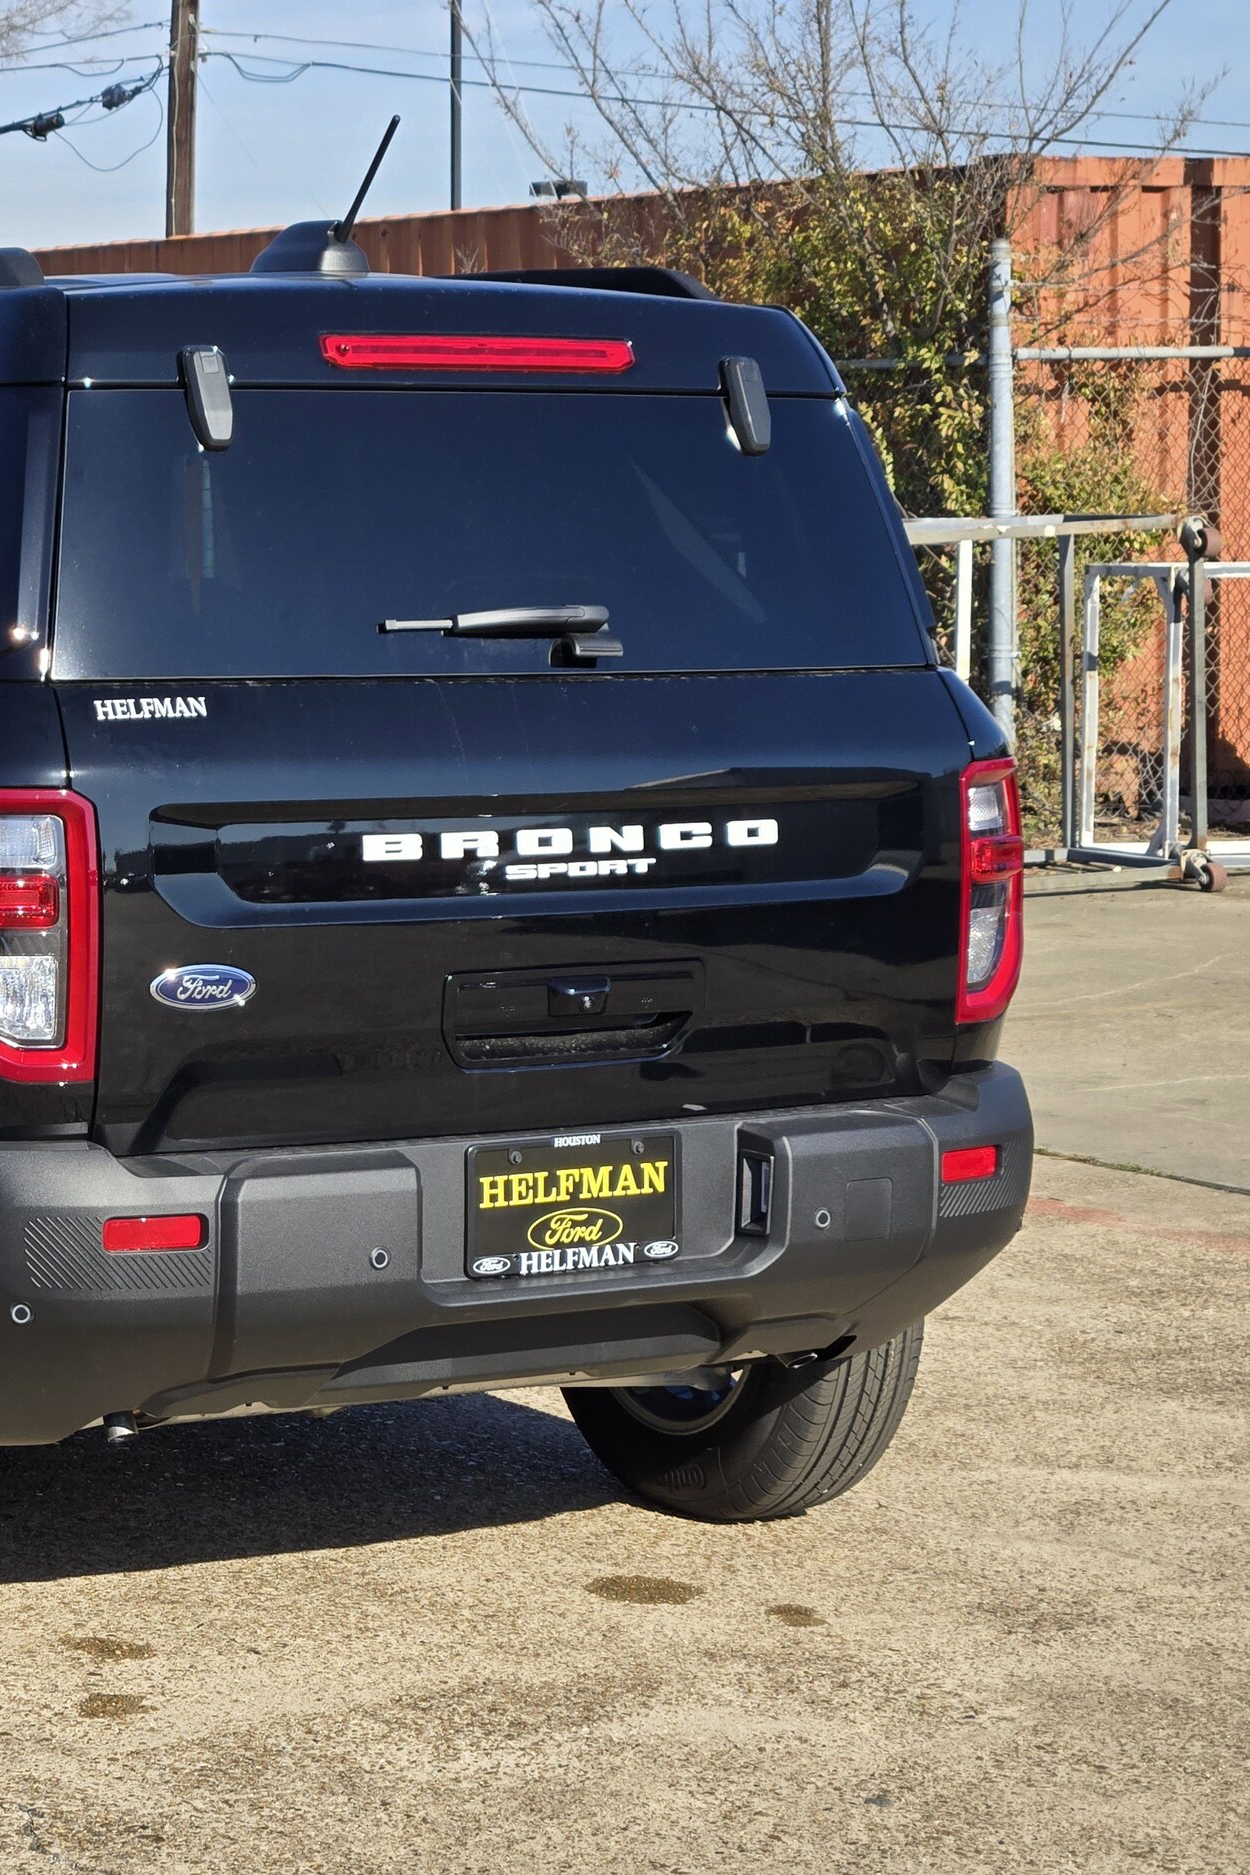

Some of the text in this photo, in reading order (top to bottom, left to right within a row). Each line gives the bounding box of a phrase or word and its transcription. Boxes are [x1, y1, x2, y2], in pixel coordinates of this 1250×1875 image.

[93, 697, 207, 720] HELFMAN
[362, 818, 779, 862] BRONCO
[505, 857, 657, 880] SPORT
[176, 974, 233, 1000] Ford
[553, 1134, 601, 1147] HOUSTON
[479, 1161, 668, 1209] HELFMAN
[544, 1213, 604, 1245] Ford
[479, 1242, 673, 1276] Ford HELFMAN Ford
